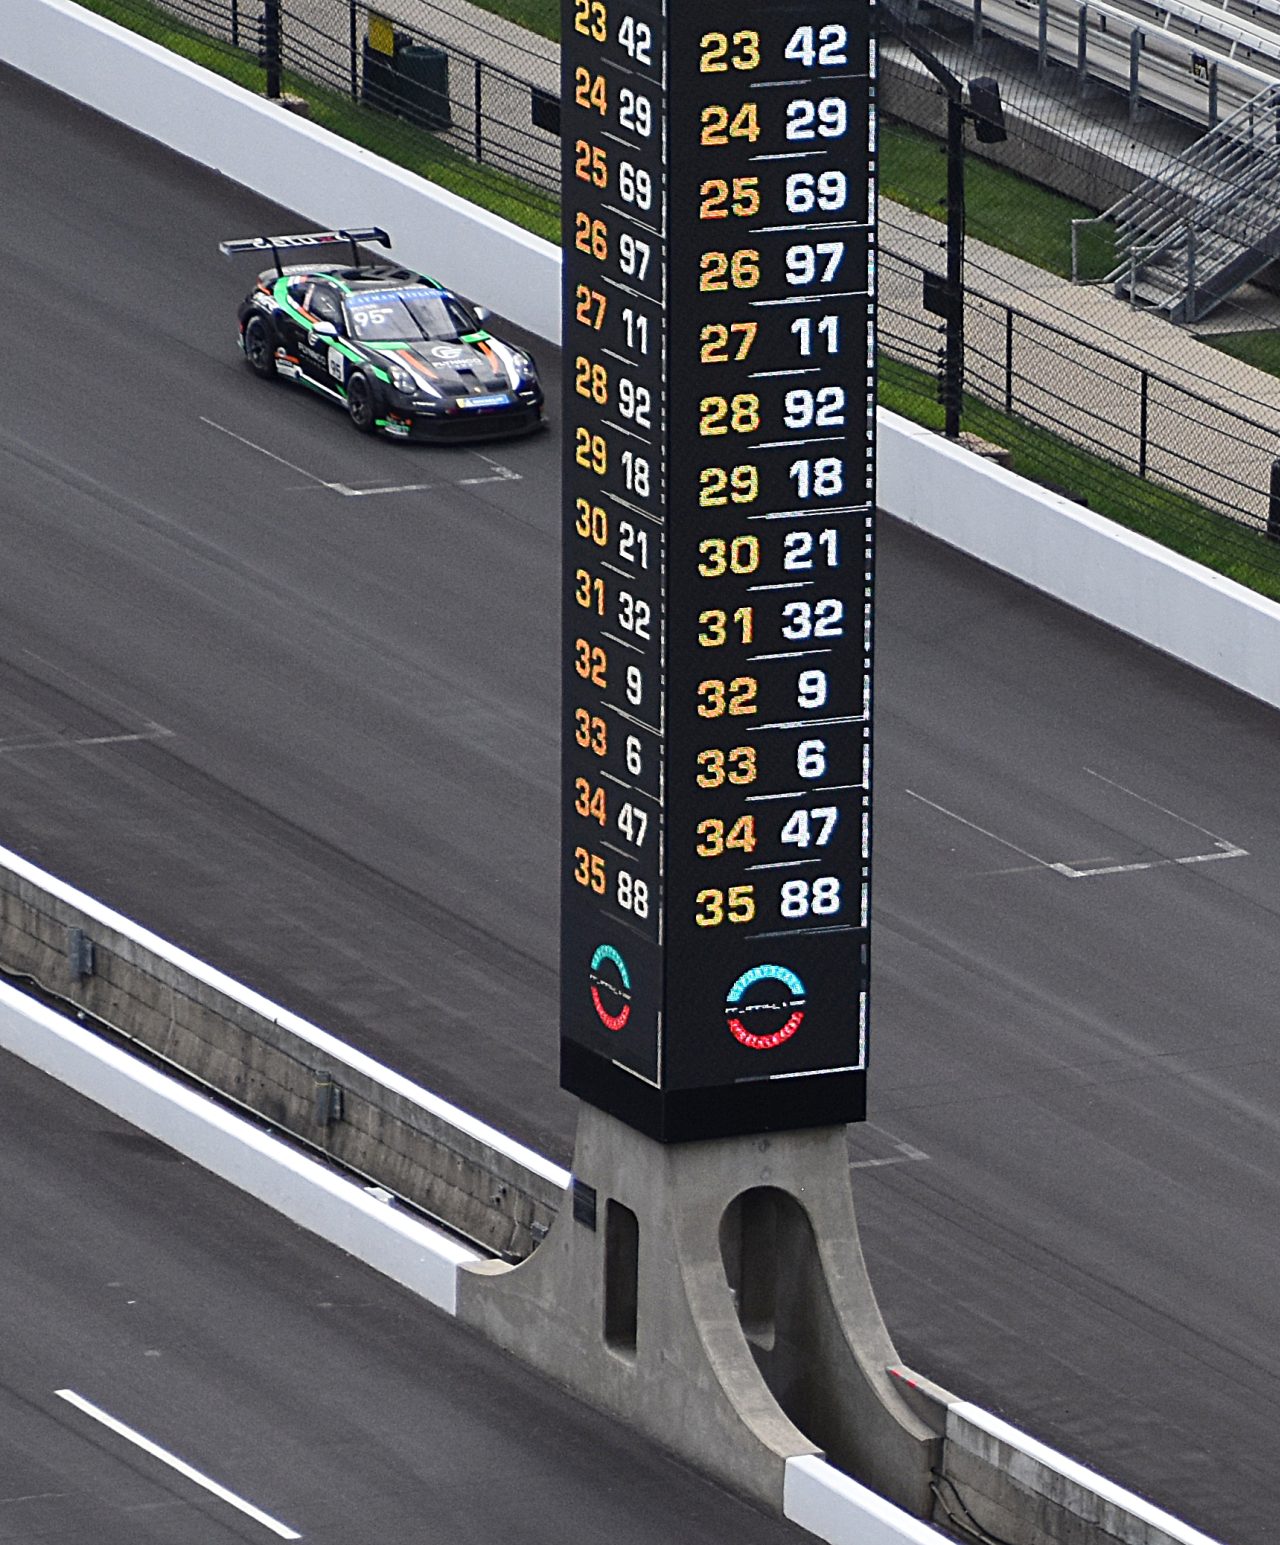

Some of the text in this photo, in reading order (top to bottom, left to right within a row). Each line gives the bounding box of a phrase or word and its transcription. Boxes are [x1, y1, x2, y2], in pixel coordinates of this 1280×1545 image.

[575, 0, 651, 65] 23 42
[700, 24, 847, 72] 23 42
[576, 67, 651, 137] 24 29
[701, 97, 847, 145] 24 29
[576, 140, 651, 210] 25 69
[700, 171, 847, 219] 25 69
[576, 212, 650, 280] 26 97
[700, 242, 844, 291] 26 97
[353, 309, 384, 327] 95
[577, 284, 647, 354] 27 11
[700, 315, 838, 363] 27 11
[576, 356, 650, 429] 28 92
[700, 387, 845, 435] 28 92
[576, 428, 649, 497] 29 18
[699, 457, 843, 506] 29 18
[576, 498, 647, 569] 30 21
[698, 529, 838, 576] 30 21
[576, 569, 650, 640] 31 32
[699, 599, 843, 646] 31 32
[576, 639, 641, 705] 32 9
[698, 670, 827, 718] 32 9
[576, 708, 641, 775] 33 6
[697, 740, 826, 788] 33 6
[575, 777, 647, 846] 34 47
[697, 807, 838, 856] 34 47
[575, 847, 648, 918] 35 88
[696, 877, 840, 926] 35 88
